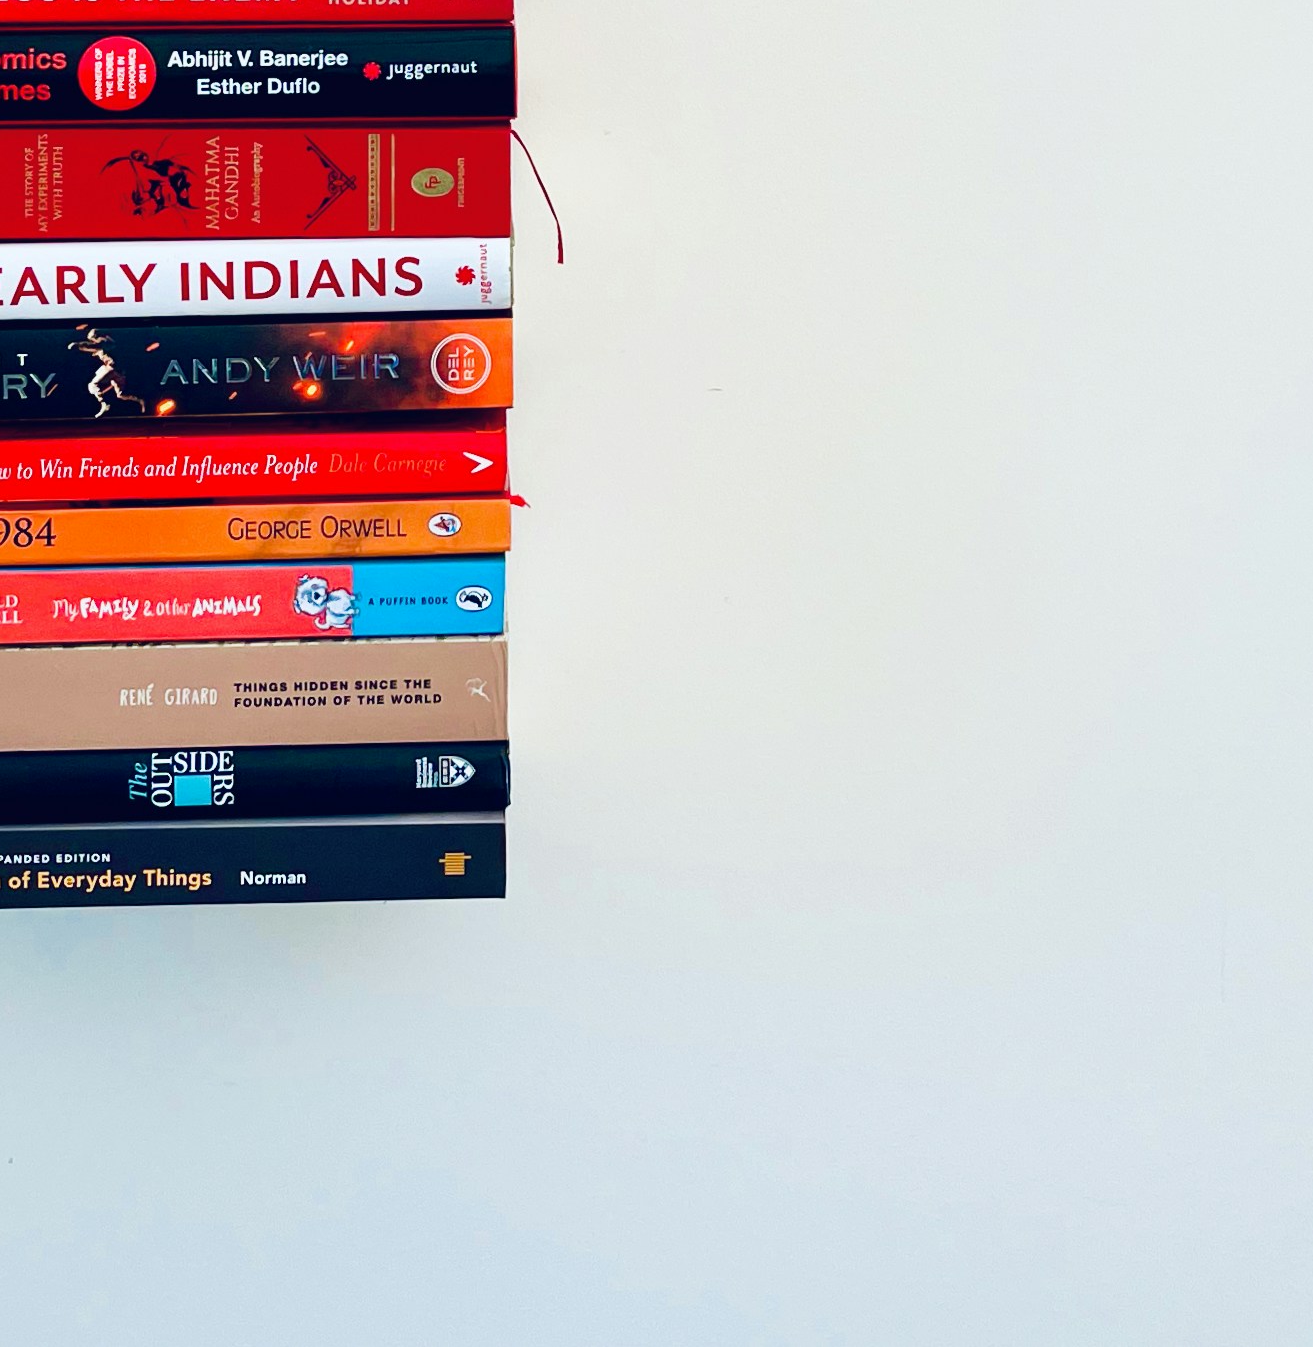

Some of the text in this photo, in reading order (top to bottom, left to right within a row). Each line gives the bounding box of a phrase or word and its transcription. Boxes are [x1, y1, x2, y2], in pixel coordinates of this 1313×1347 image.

[167, 49, 349, 71] Abhijit V. Banerjee
[386, 60, 478, 80] juggernaut
[197, 77, 321, 95] Esther Duflo
[25, 148, 35, 162] OF
[25, 163, 34, 196] STORY
[37, 133, 49, 232] MY EXPERIMENTS
[52, 146, 64, 220] WITH TRUTH
[205, 136, 220, 230] MAHATMA
[224, 146, 240, 221] GANDHI
[250, 142, 264, 224] An Autobiography
[180, 256, 423, 302] INDIANS
[480, 243, 492, 304] juggernaut
[160, 353, 400, 386] ANDY WEIR
[448, 347, 461, 382] DEL
[463, 344, 476, 381] REY
[16, 462, 33, 479] to
[40, 458, 73, 479] Win
[78, 457, 140, 479] Friends
[144, 456, 177, 477] and
[181, 454, 259, 483] Influence
[264, 453, 319, 481] People
[329, 452, 368, 474] Dale
[373, 452, 447, 478] Carnegie
[227, 515, 407, 541] GEORGE ORWELL
[53, 599, 79, 622] My
[368, 595, 449, 606] A PUFFIN BOOK
[119, 683, 218, 707] RENÉ GIRARD
[234, 678, 432, 693] THINGS HIDDEN SINCE THE
[234, 693, 443, 709] FOUNDATION OF THE WORLD
[128, 762, 148, 800] The
[56, 853, 111, 863] EDITION
[8, 870, 31, 890] of
[38, 870, 137, 893] Everyday
[143, 868, 212, 891] Things
[240, 870, 306, 886] Norman
